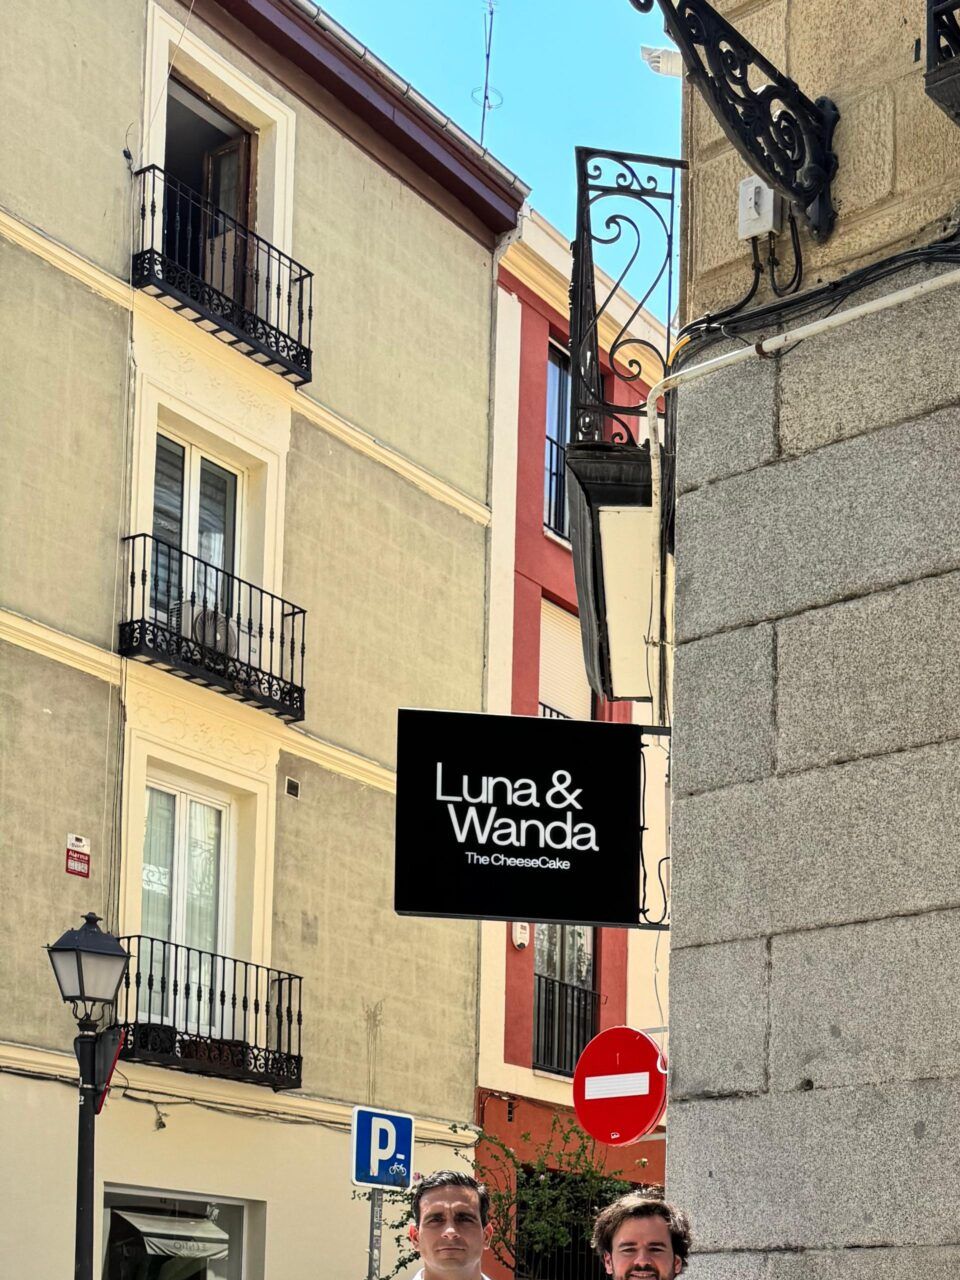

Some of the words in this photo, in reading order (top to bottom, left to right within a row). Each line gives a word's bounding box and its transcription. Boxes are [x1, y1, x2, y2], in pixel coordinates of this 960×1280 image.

[436, 762, 541, 808] Luna
[545, 770, 584, 810] &
[447, 803, 600, 852] Wanda
[465, 851, 490, 865] The
[490, 853, 571, 870] CheeseCake
[370, 1116, 397, 1177] P
